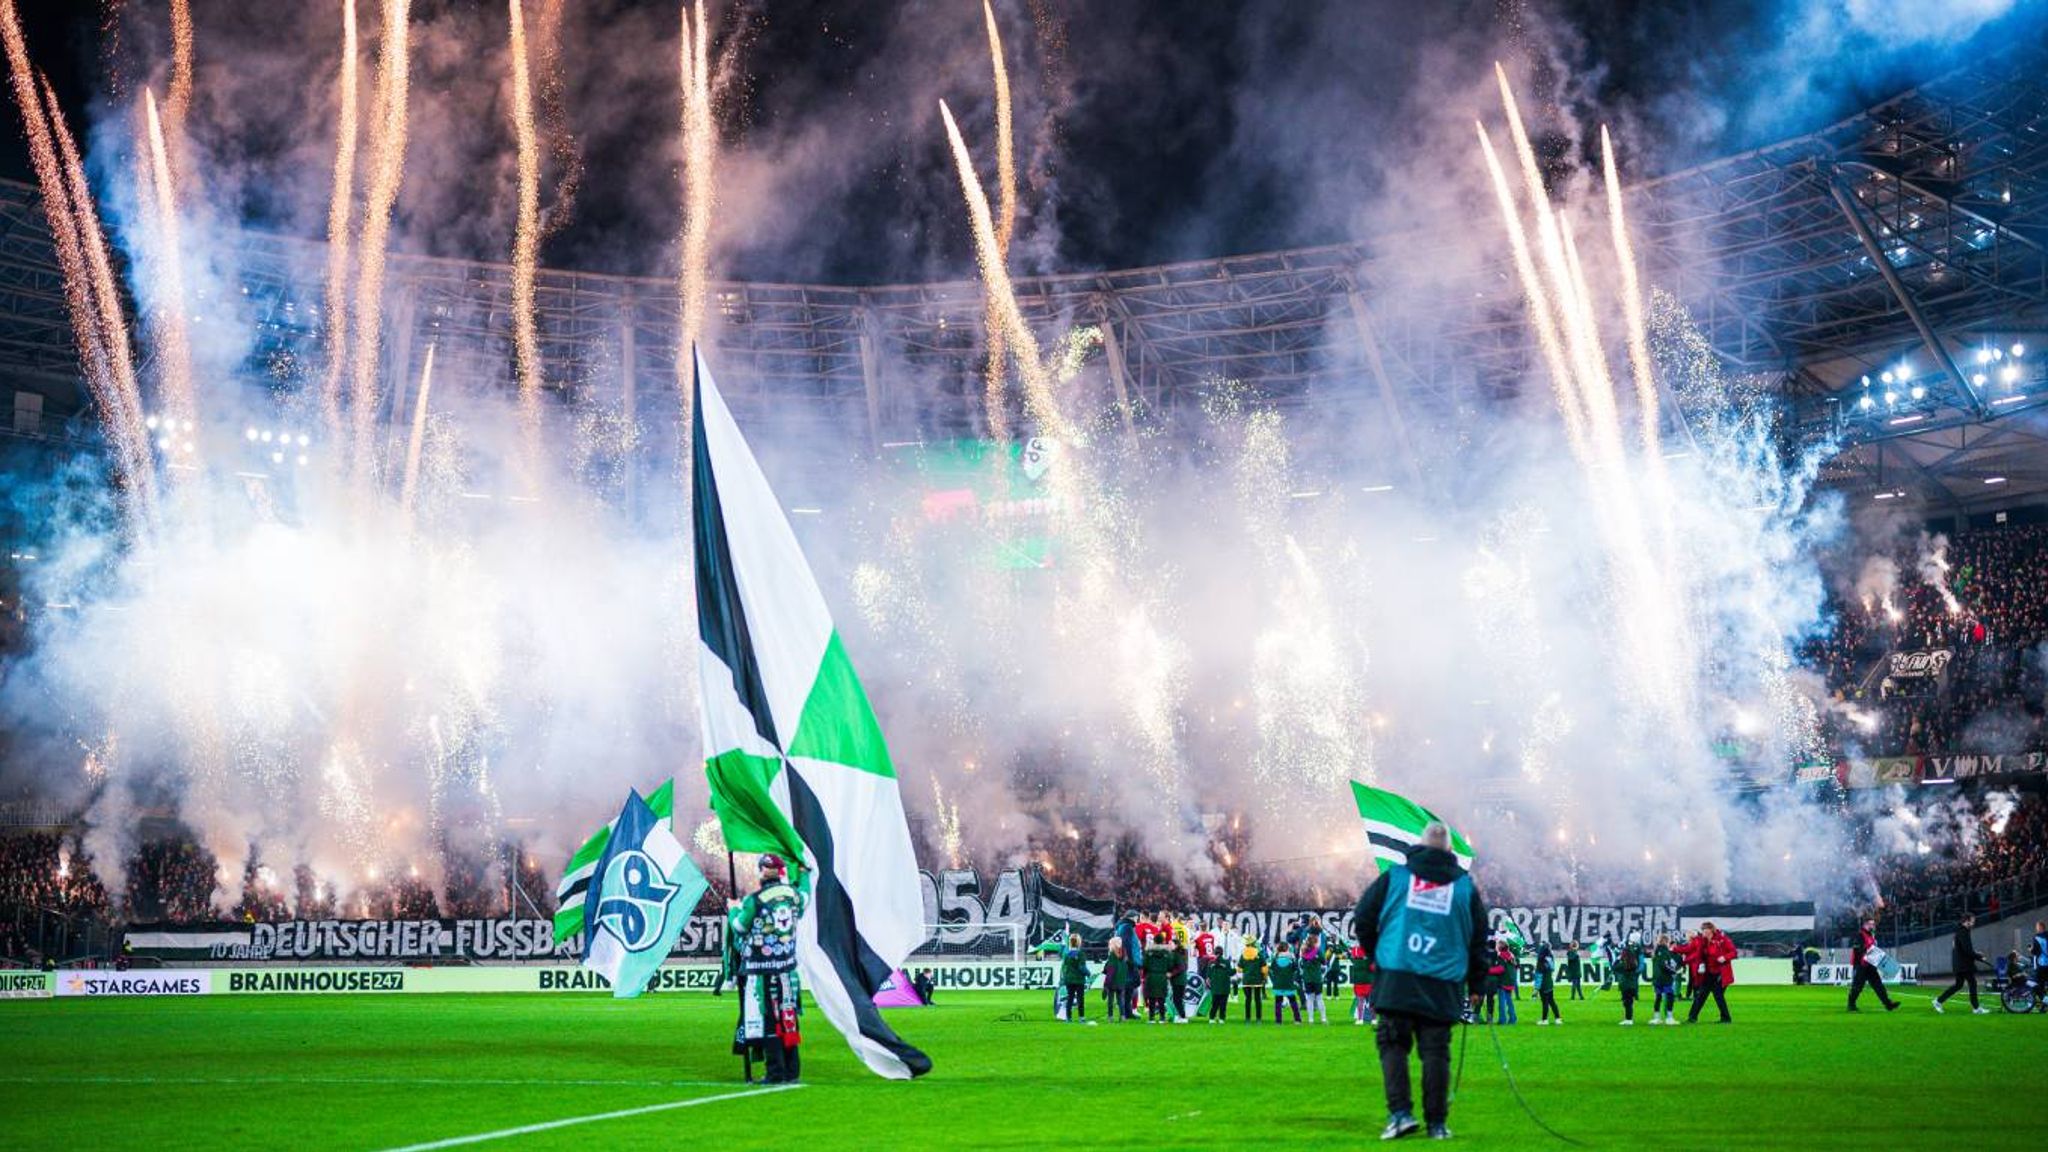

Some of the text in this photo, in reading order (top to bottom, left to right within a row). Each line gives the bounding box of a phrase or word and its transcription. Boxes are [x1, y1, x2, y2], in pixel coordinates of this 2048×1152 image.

[210, 942, 227, 959] 70
[1407, 932, 1437, 955] 07
[88, 979, 200, 994] STARGAMES
